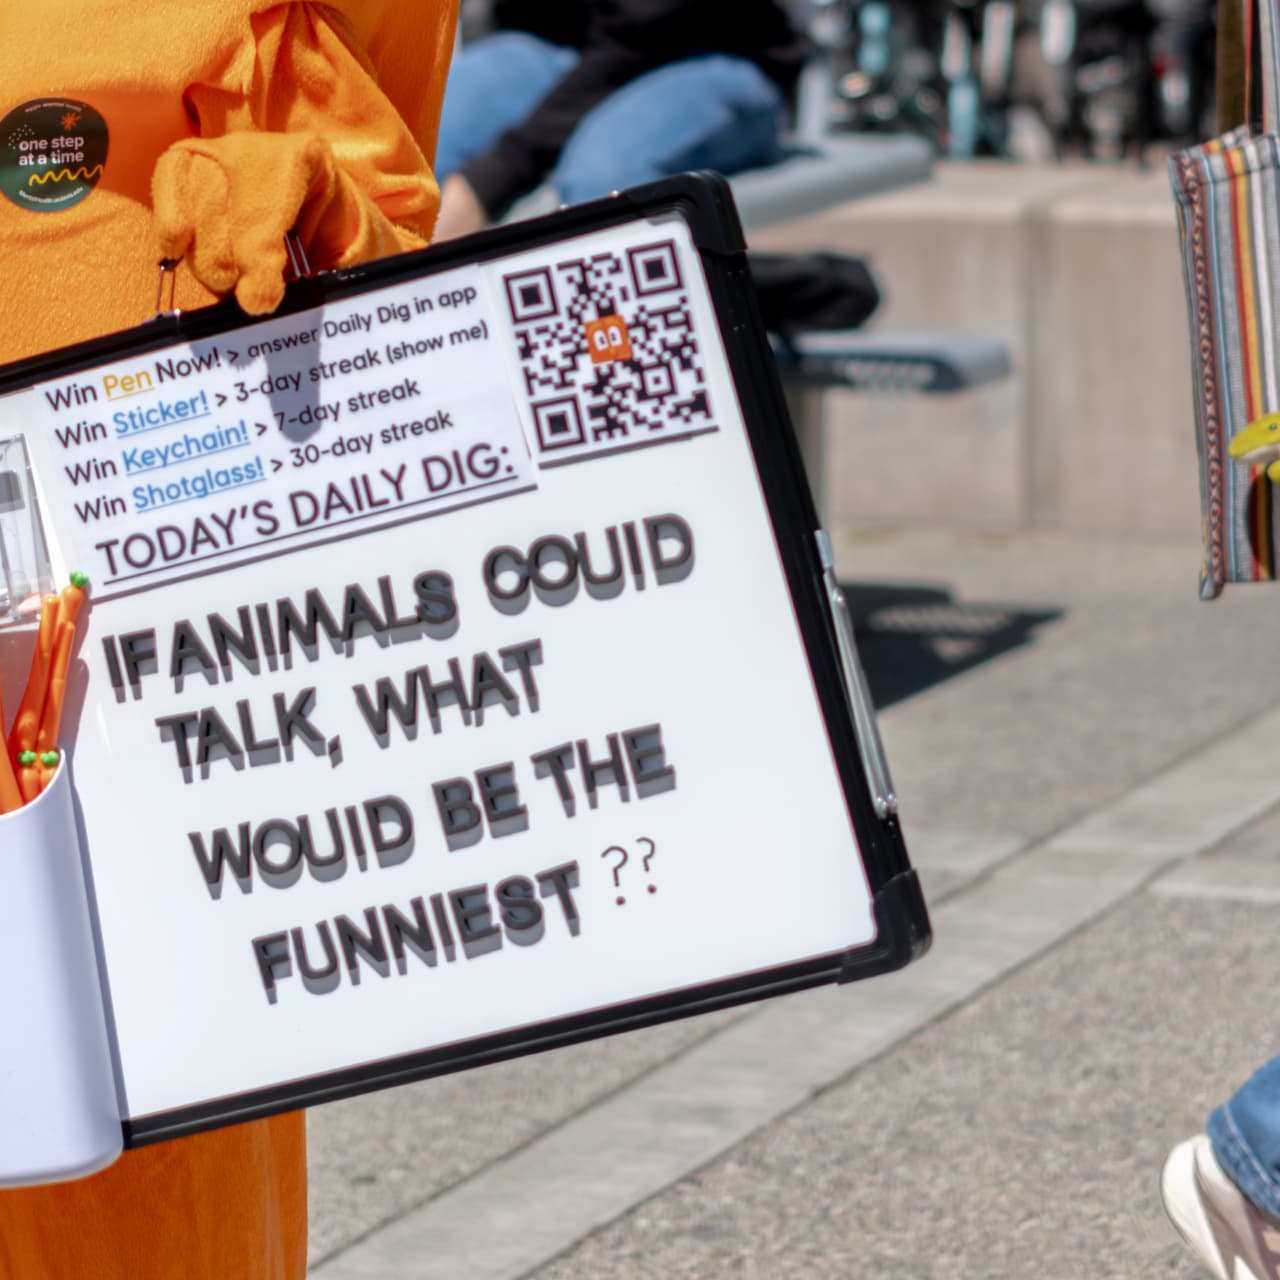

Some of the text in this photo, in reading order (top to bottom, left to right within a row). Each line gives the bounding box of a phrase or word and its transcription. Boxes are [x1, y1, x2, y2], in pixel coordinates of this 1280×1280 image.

[19, 135, 84, 151] one step
[19, 149, 84, 166] at a time
[45, 383, 98, 412] Win
[102, 369, 153, 398] Pen
[154, 346, 222, 384] Now!
[247, 328, 319, 359] answer
[323, 312, 373, 339] Daily
[376, 303, 411, 325] Dig
[413, 296, 433, 315] in
[437, 285, 477, 309] app
[55, 420, 108, 449] Win
[112, 389, 210, 435] Sticker!
[233, 371, 302, 403] 3-day
[309, 348, 381, 383] streak
[385, 333, 444, 364] (show
[448, 318, 489, 345] me)
[64, 457, 118, 486] Win
[121, 418, 250, 472] Keychain!
[273, 401, 341, 433] 7-day
[347, 377, 421, 413] streak
[73, 495, 127, 524] Win
[131, 455, 266, 509] Shotglass!
[289, 431, 374, 469] 30-day
[381, 409, 454, 445] streak
[95, 441, 516, 577] TODAY'S DAILY DIG:
[169, 569, 458, 686] ANIMALS
[155, 638, 544, 770] TALK, WHAT
[431, 761, 529, 844] BE
[530, 723, 677, 806] THE
[252, 836, 657, 996] FUNNIEST ??
